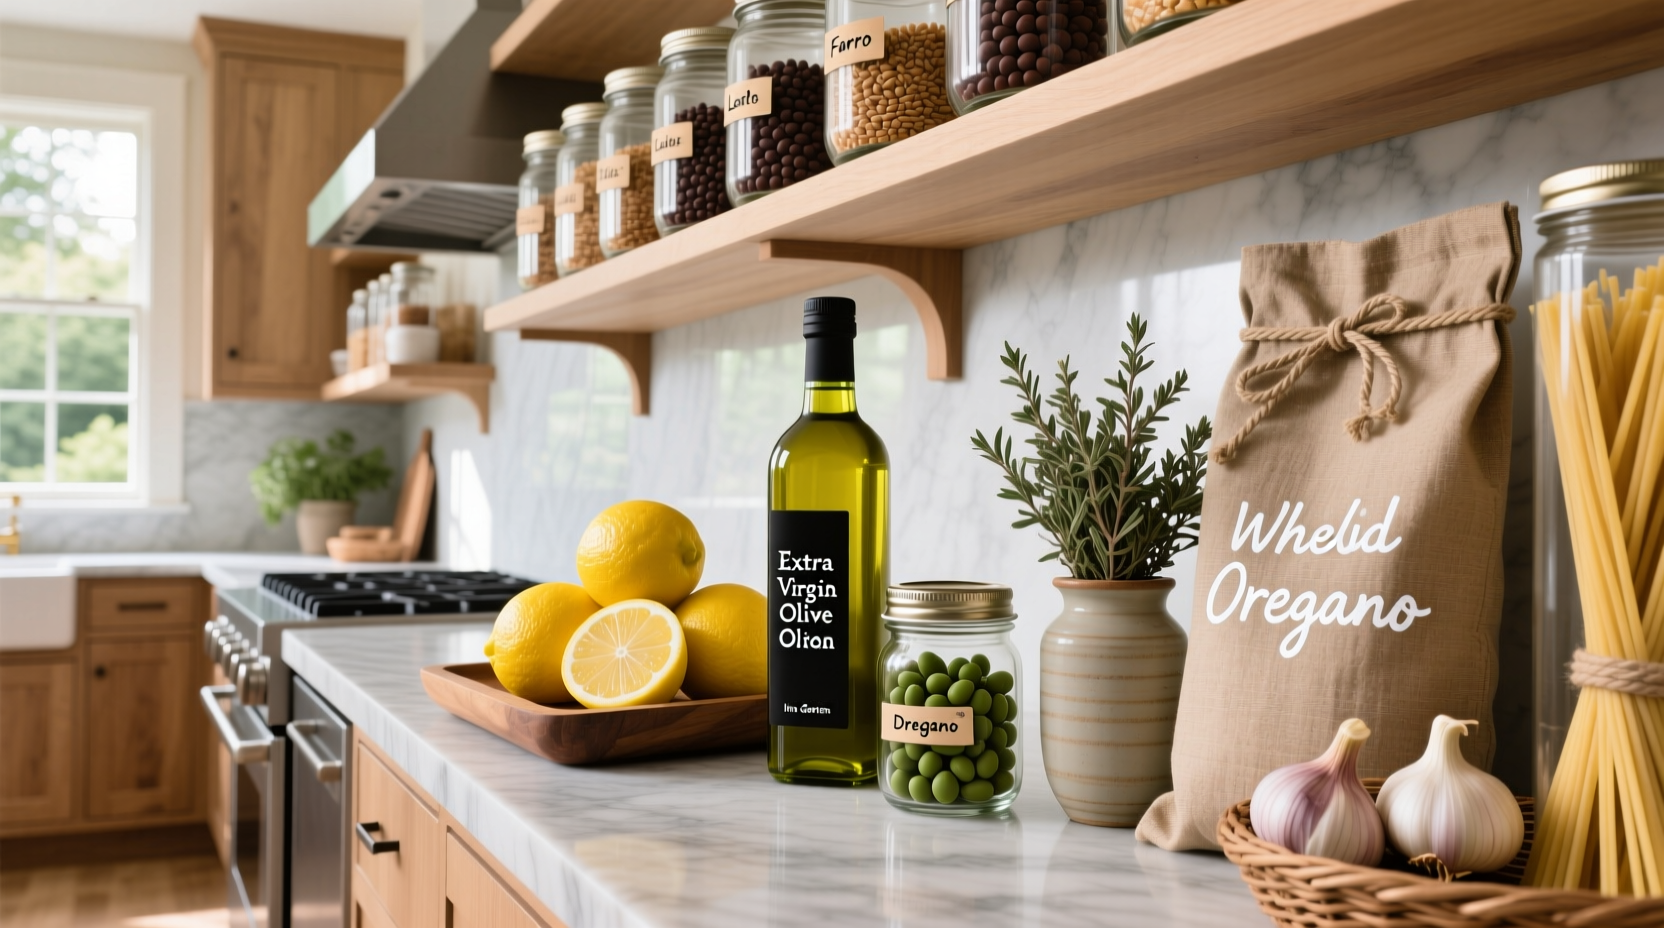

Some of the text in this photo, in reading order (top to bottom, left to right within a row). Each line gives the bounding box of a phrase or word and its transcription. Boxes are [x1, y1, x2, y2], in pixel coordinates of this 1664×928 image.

[830, 34, 872, 58] Farro
[777, 550, 835, 572] Extra
[777, 577, 838, 604] Virgin
[779, 602, 834, 624] Olive
[1206, 561, 1432, 659] Oregano
